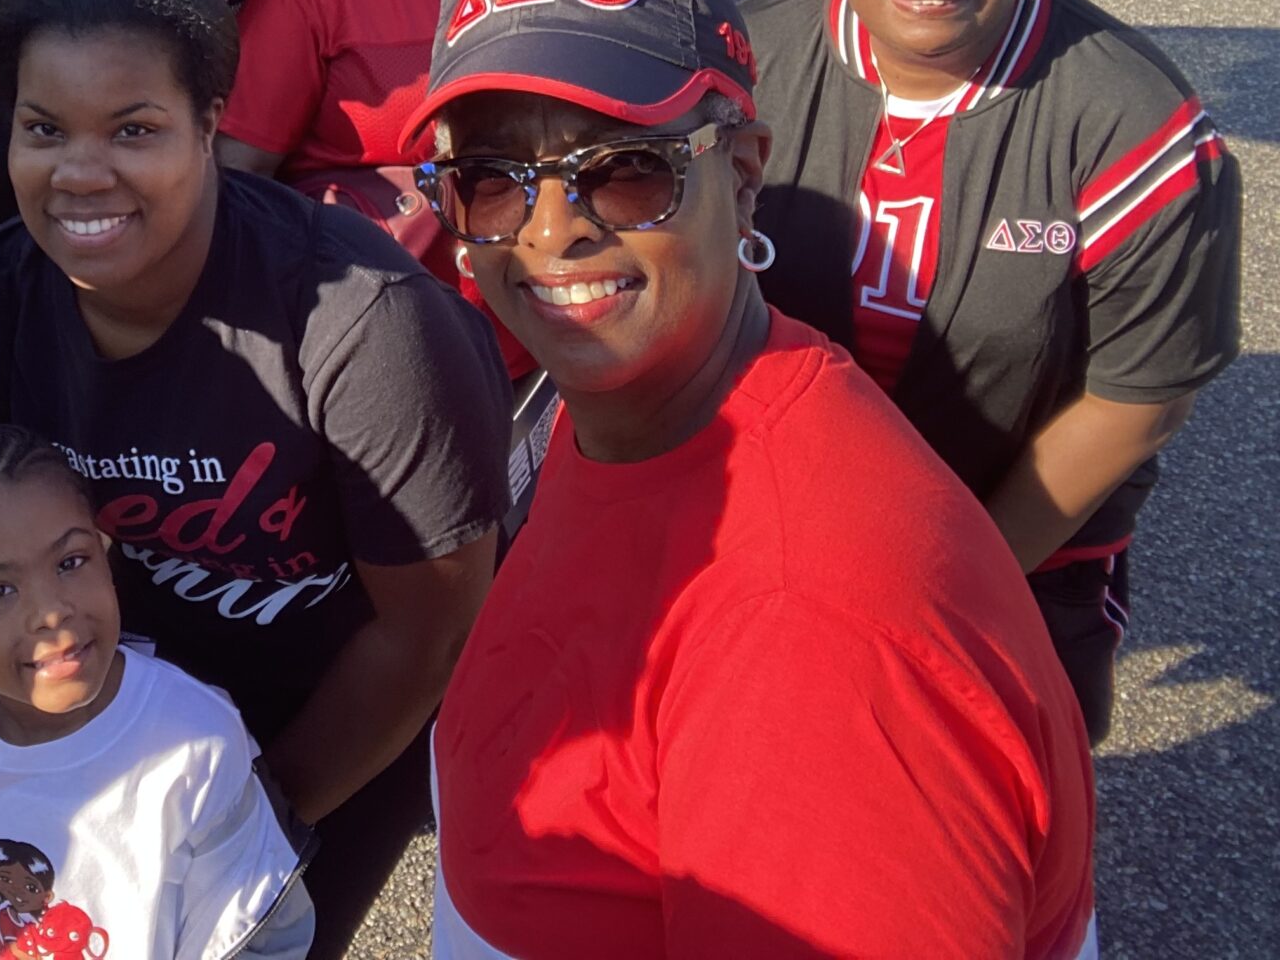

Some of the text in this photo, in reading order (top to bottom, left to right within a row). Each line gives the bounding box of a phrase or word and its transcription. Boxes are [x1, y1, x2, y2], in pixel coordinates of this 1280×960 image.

[986, 218, 1076, 255] ΔΣΘ
[52, 442, 226, 495] astating in
[96, 441, 276, 554] ed
